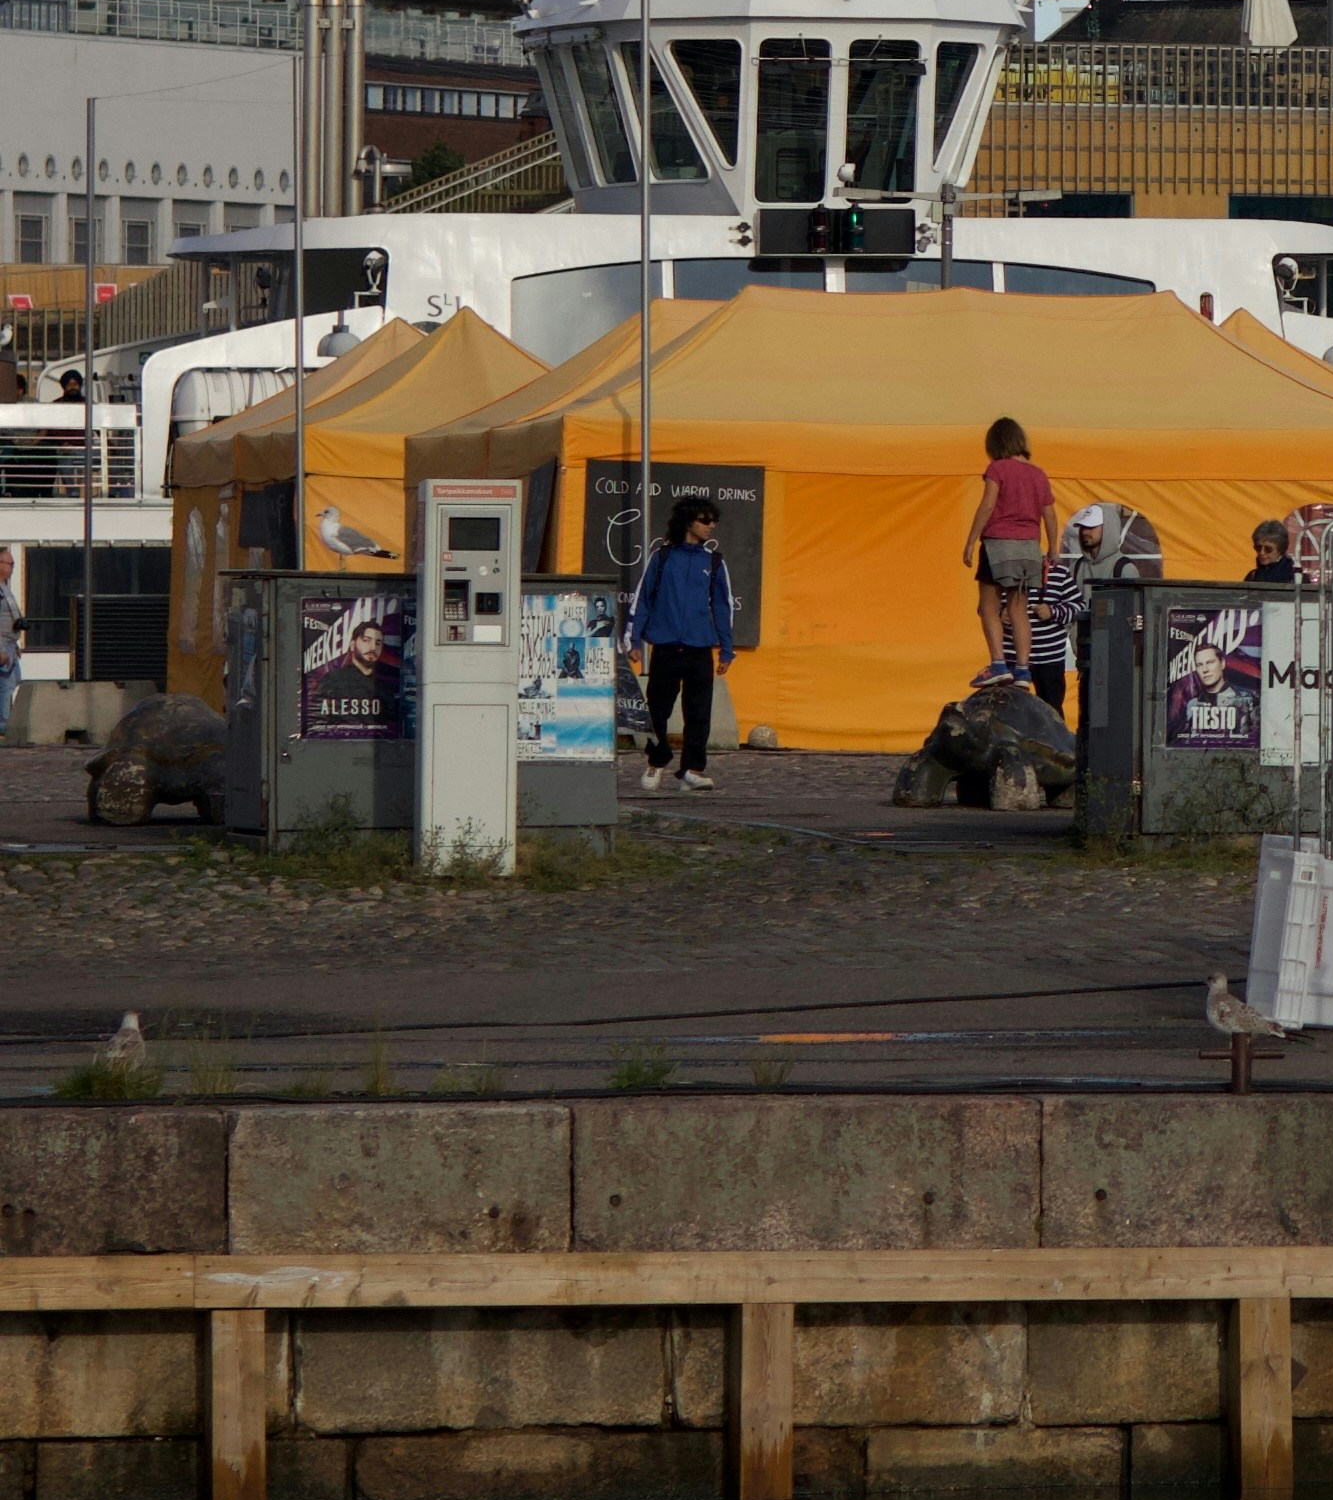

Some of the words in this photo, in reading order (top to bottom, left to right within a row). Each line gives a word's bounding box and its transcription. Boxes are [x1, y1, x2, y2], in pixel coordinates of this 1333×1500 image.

[595, 477, 629, 494] COLD
[671, 483, 710, 498] WARM
[718, 488, 756, 501] DRINKS
[321, 699, 380, 715] ALESSO
